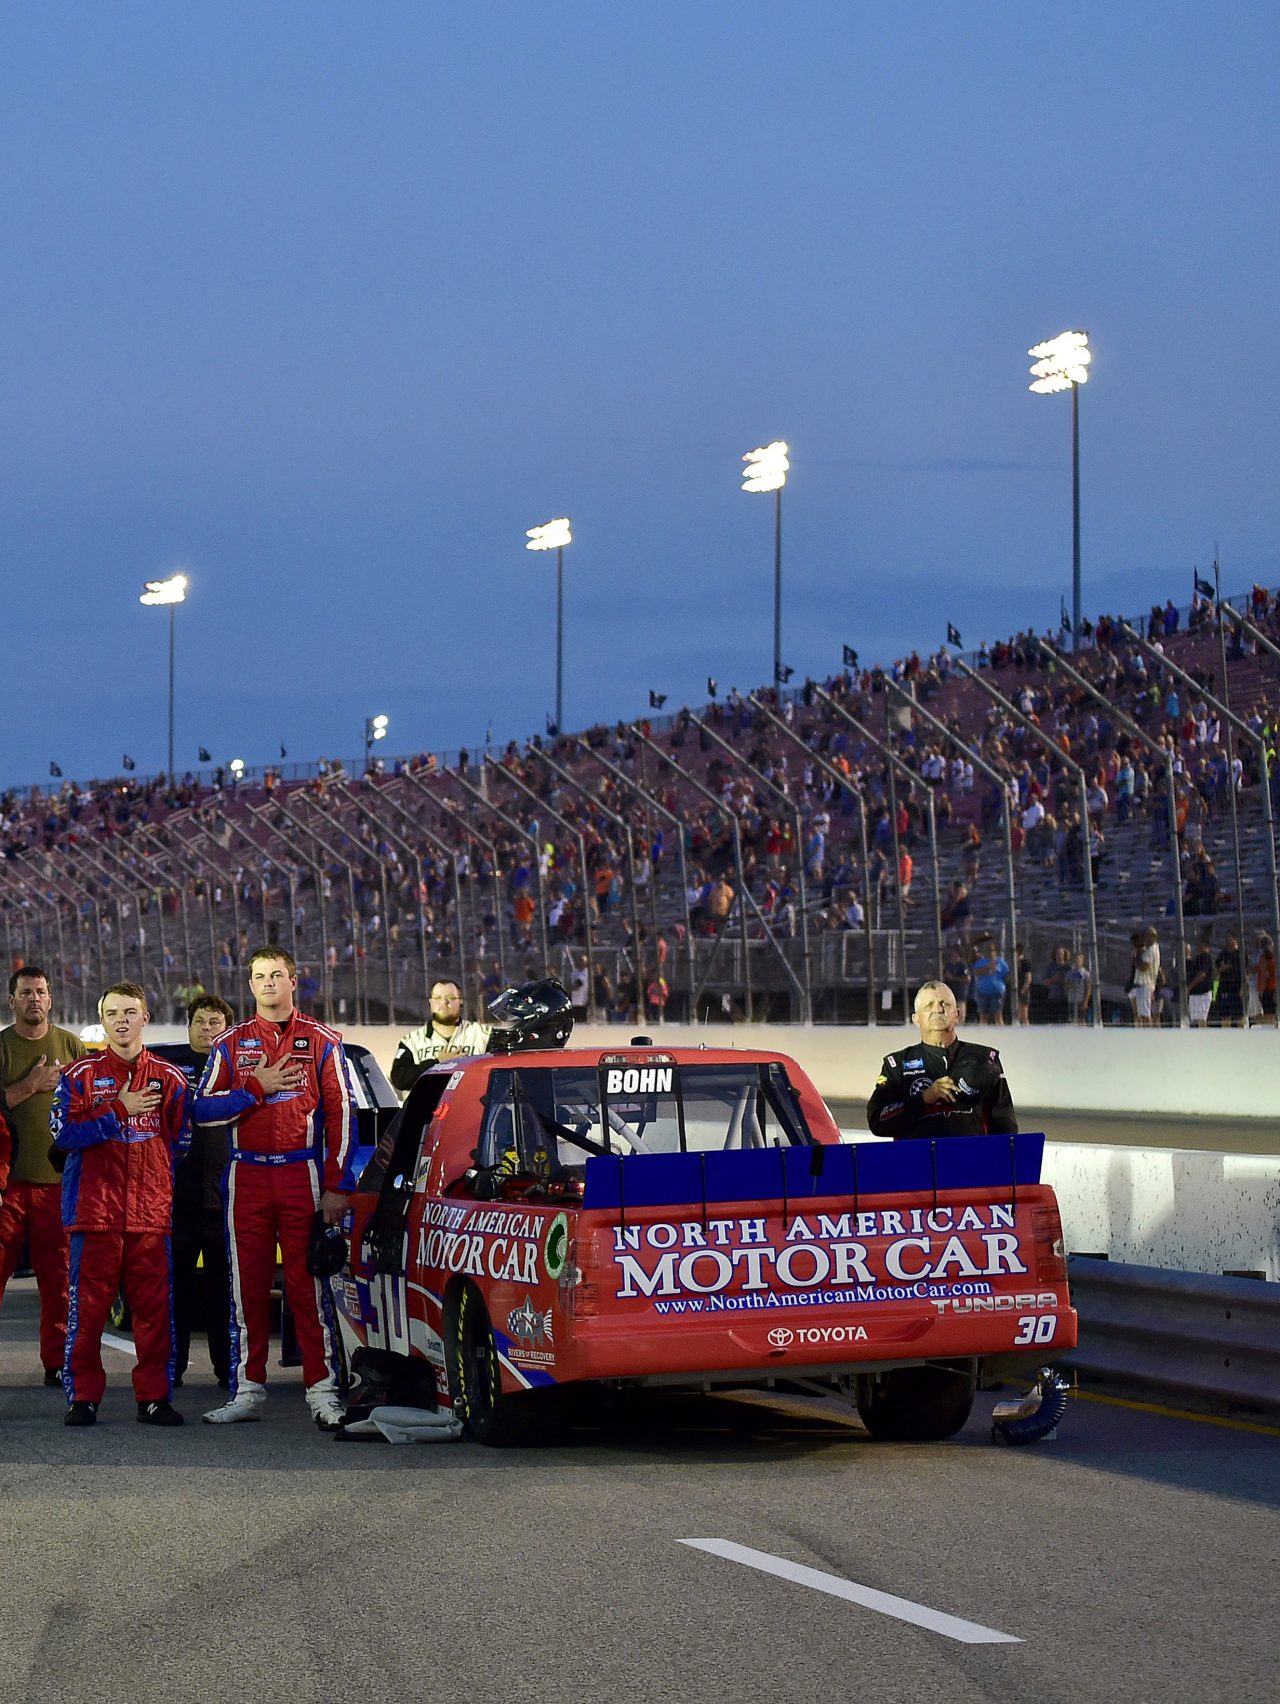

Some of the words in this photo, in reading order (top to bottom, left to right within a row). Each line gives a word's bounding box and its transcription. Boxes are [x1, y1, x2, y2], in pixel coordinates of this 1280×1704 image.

[607, 1069, 673, 1093] BOHN
[422, 1202, 466, 1229] NORTH
[464, 1211, 545, 1239] AMERICAN
[613, 1218, 767, 1250] NORTH
[785, 1204, 1015, 1241] AMERICAN
[416, 1227, 485, 1276] MOTOR
[488, 1238, 539, 1284] CAR
[614, 1242, 875, 1297] MOTOR
[885, 1233, 1027, 1281] CAR
[654, 1280, 991, 1314] www.NorthAmericanMotorCar.com
[930, 1292, 1058, 1314] TUNDRA
[796, 1326, 868, 1343] TOYOTA
[1014, 1315, 1057, 1345] 30
[508, 1348, 525, 1358] RIVERS
[530, 1350, 555, 1361] RECOVERY
